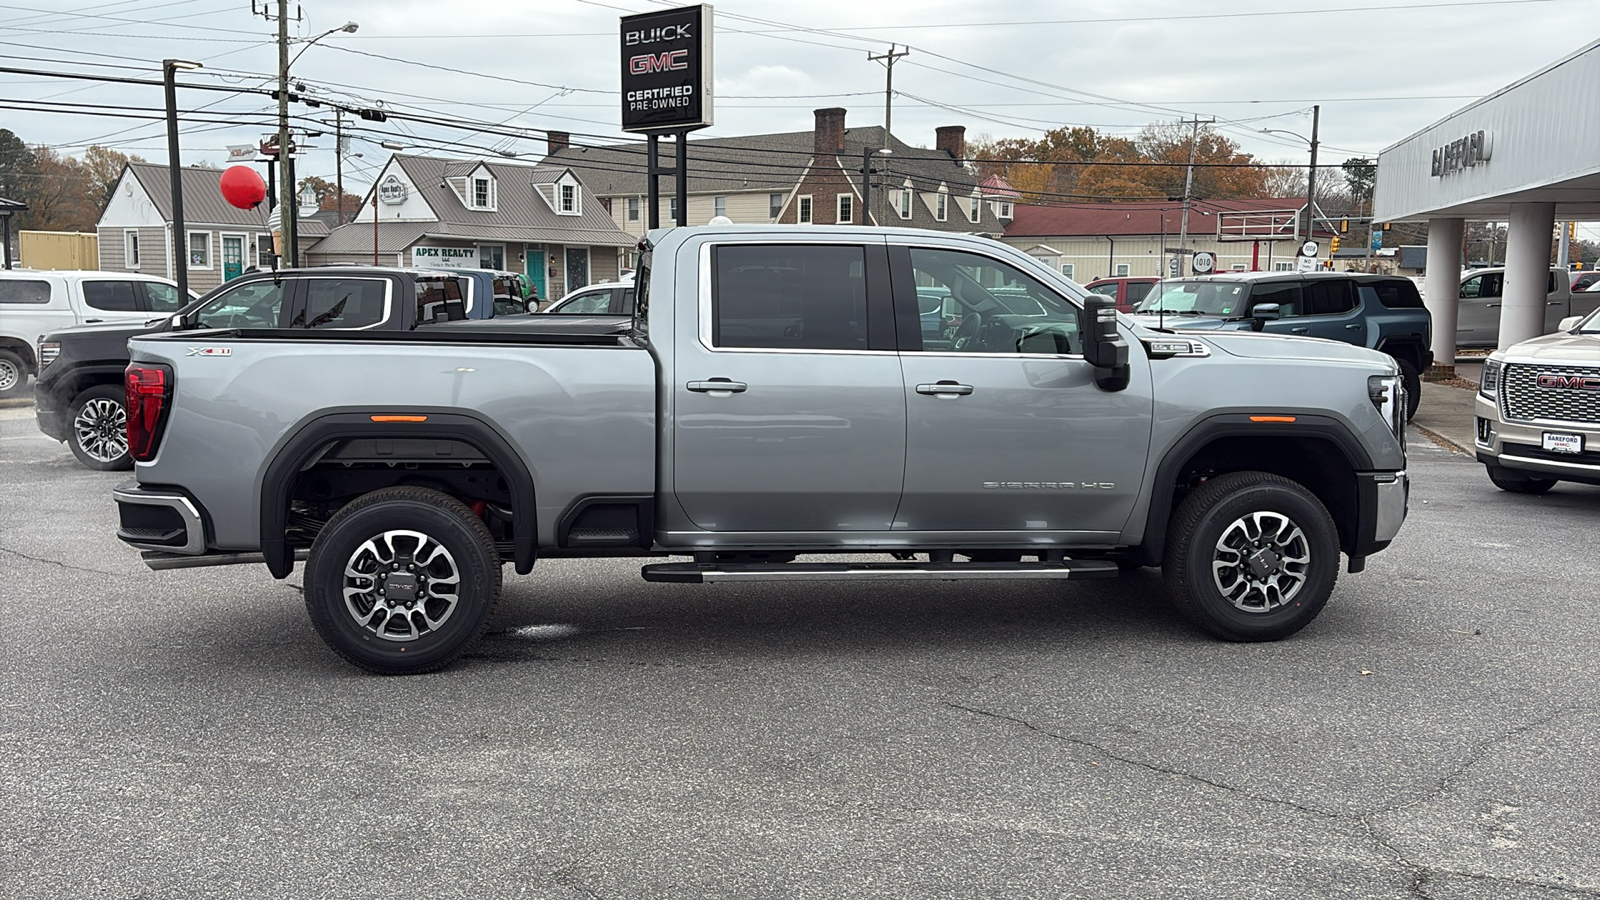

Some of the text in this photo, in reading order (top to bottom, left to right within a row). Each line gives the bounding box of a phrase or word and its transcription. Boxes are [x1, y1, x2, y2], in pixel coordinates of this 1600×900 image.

[625, 23, 692, 46] BUICK
[630, 49, 688, 75] GMC
[627, 85, 693, 102] CERTIFIED
[630, 97, 690, 112] PRE-OWNED
[1431, 129, 1493, 177] BAREFORD
[416, 248, 474, 258] APEX REALTY
[1196, 258, 1211, 267] 1010
[1538, 375, 1600, 389] GMC
[1547, 435, 1578, 444] BAREFORD
[983, 481, 1115, 490] SIERRA HD
